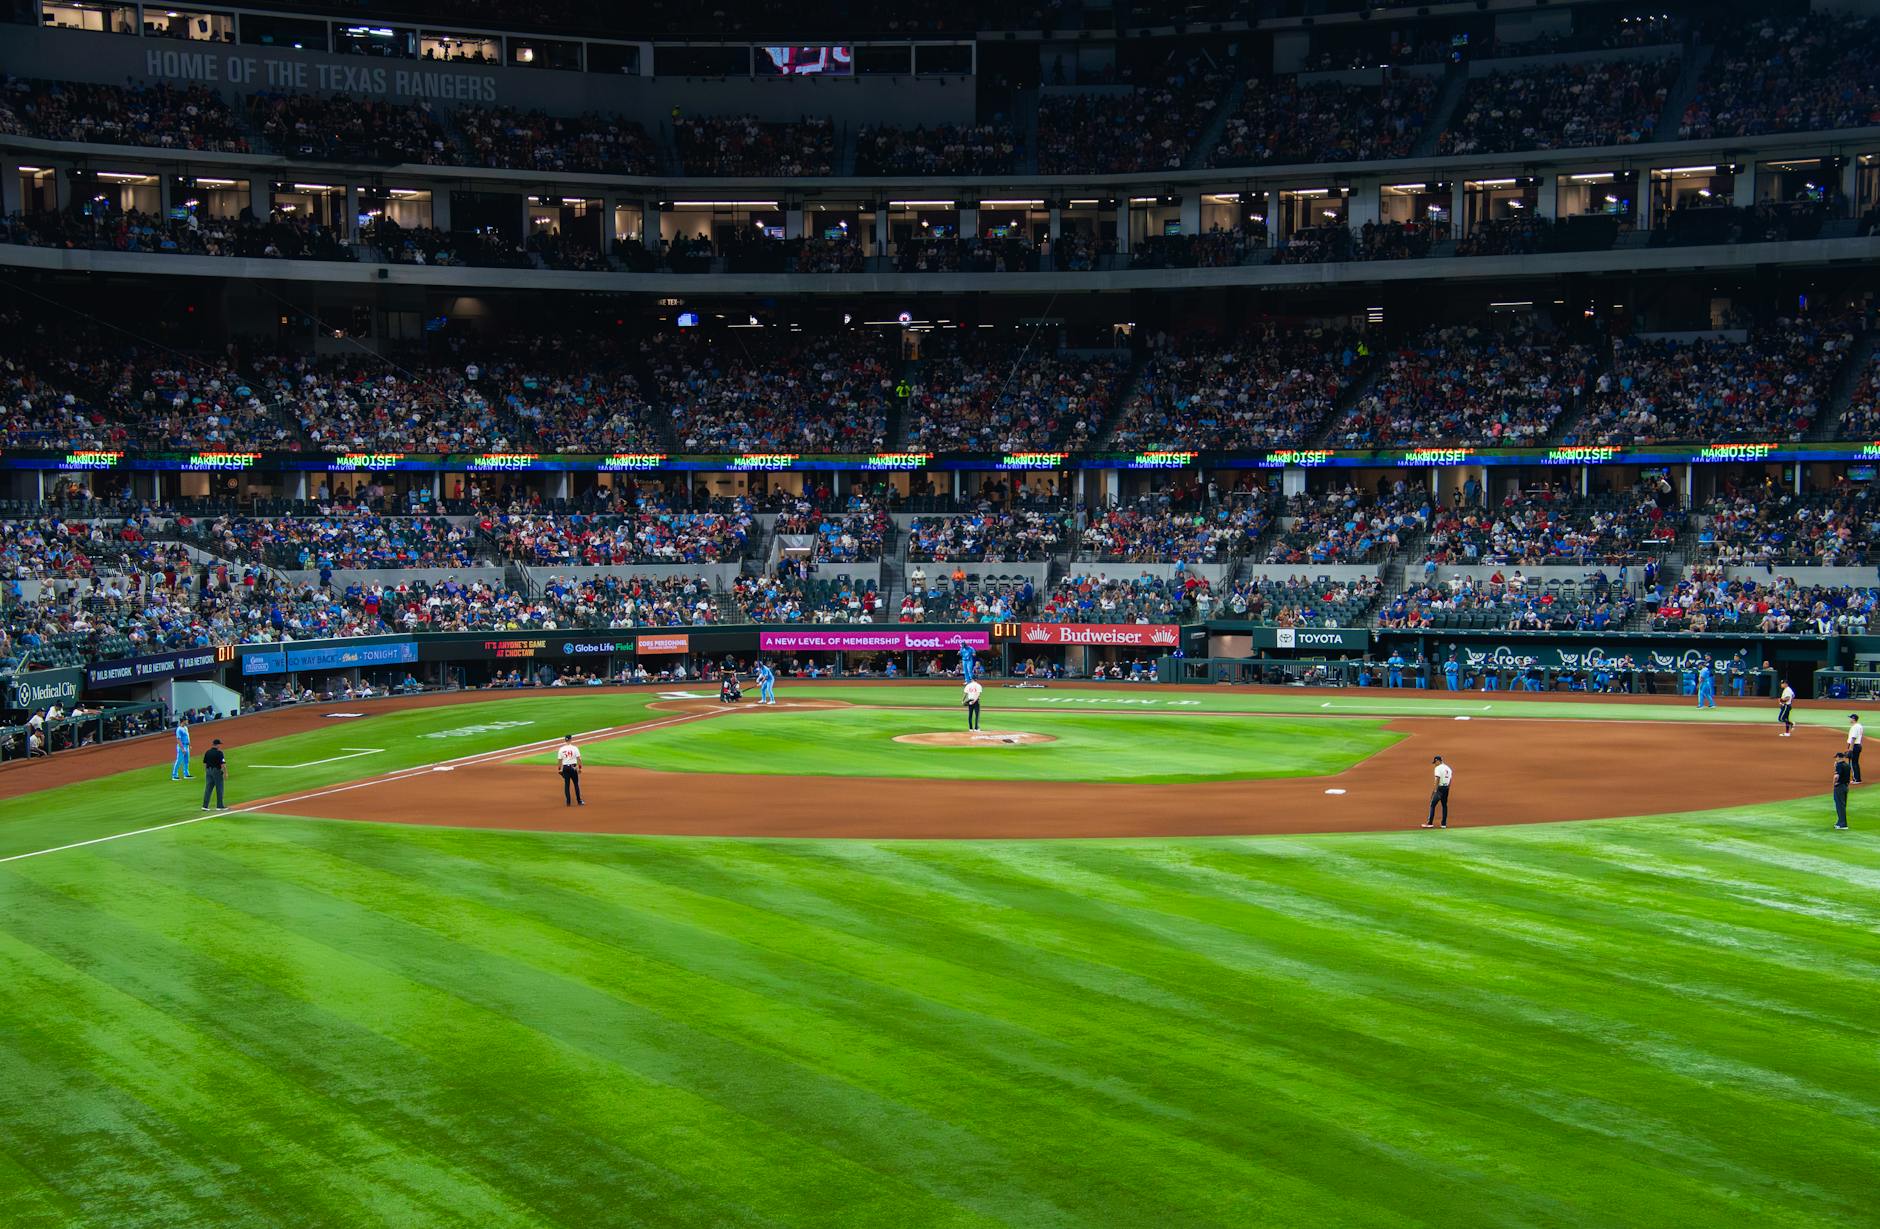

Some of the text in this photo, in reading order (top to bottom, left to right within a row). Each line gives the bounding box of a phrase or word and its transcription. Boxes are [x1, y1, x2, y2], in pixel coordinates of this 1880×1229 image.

[147, 50, 497, 101] HOME OF THE TEXAS RANGERS
[1059, 627, 1142, 643] Budweiser
[1298, 634, 1343, 644] TOYOTA
[529, 640, 546, 648] GAME
[575, 642, 633, 652] Globe Life Field
[301, 655, 316, 665] WAY
[363, 649, 398, 660] TONIGHT
[505, 649, 534, 657] CHOCTAW
[193, 655, 215, 666] NETWORK
[97, 667, 132, 680] MLB NETWORK
[142, 661, 175, 674] MLB NETWORK
[32, 682, 77, 700] Medical City
